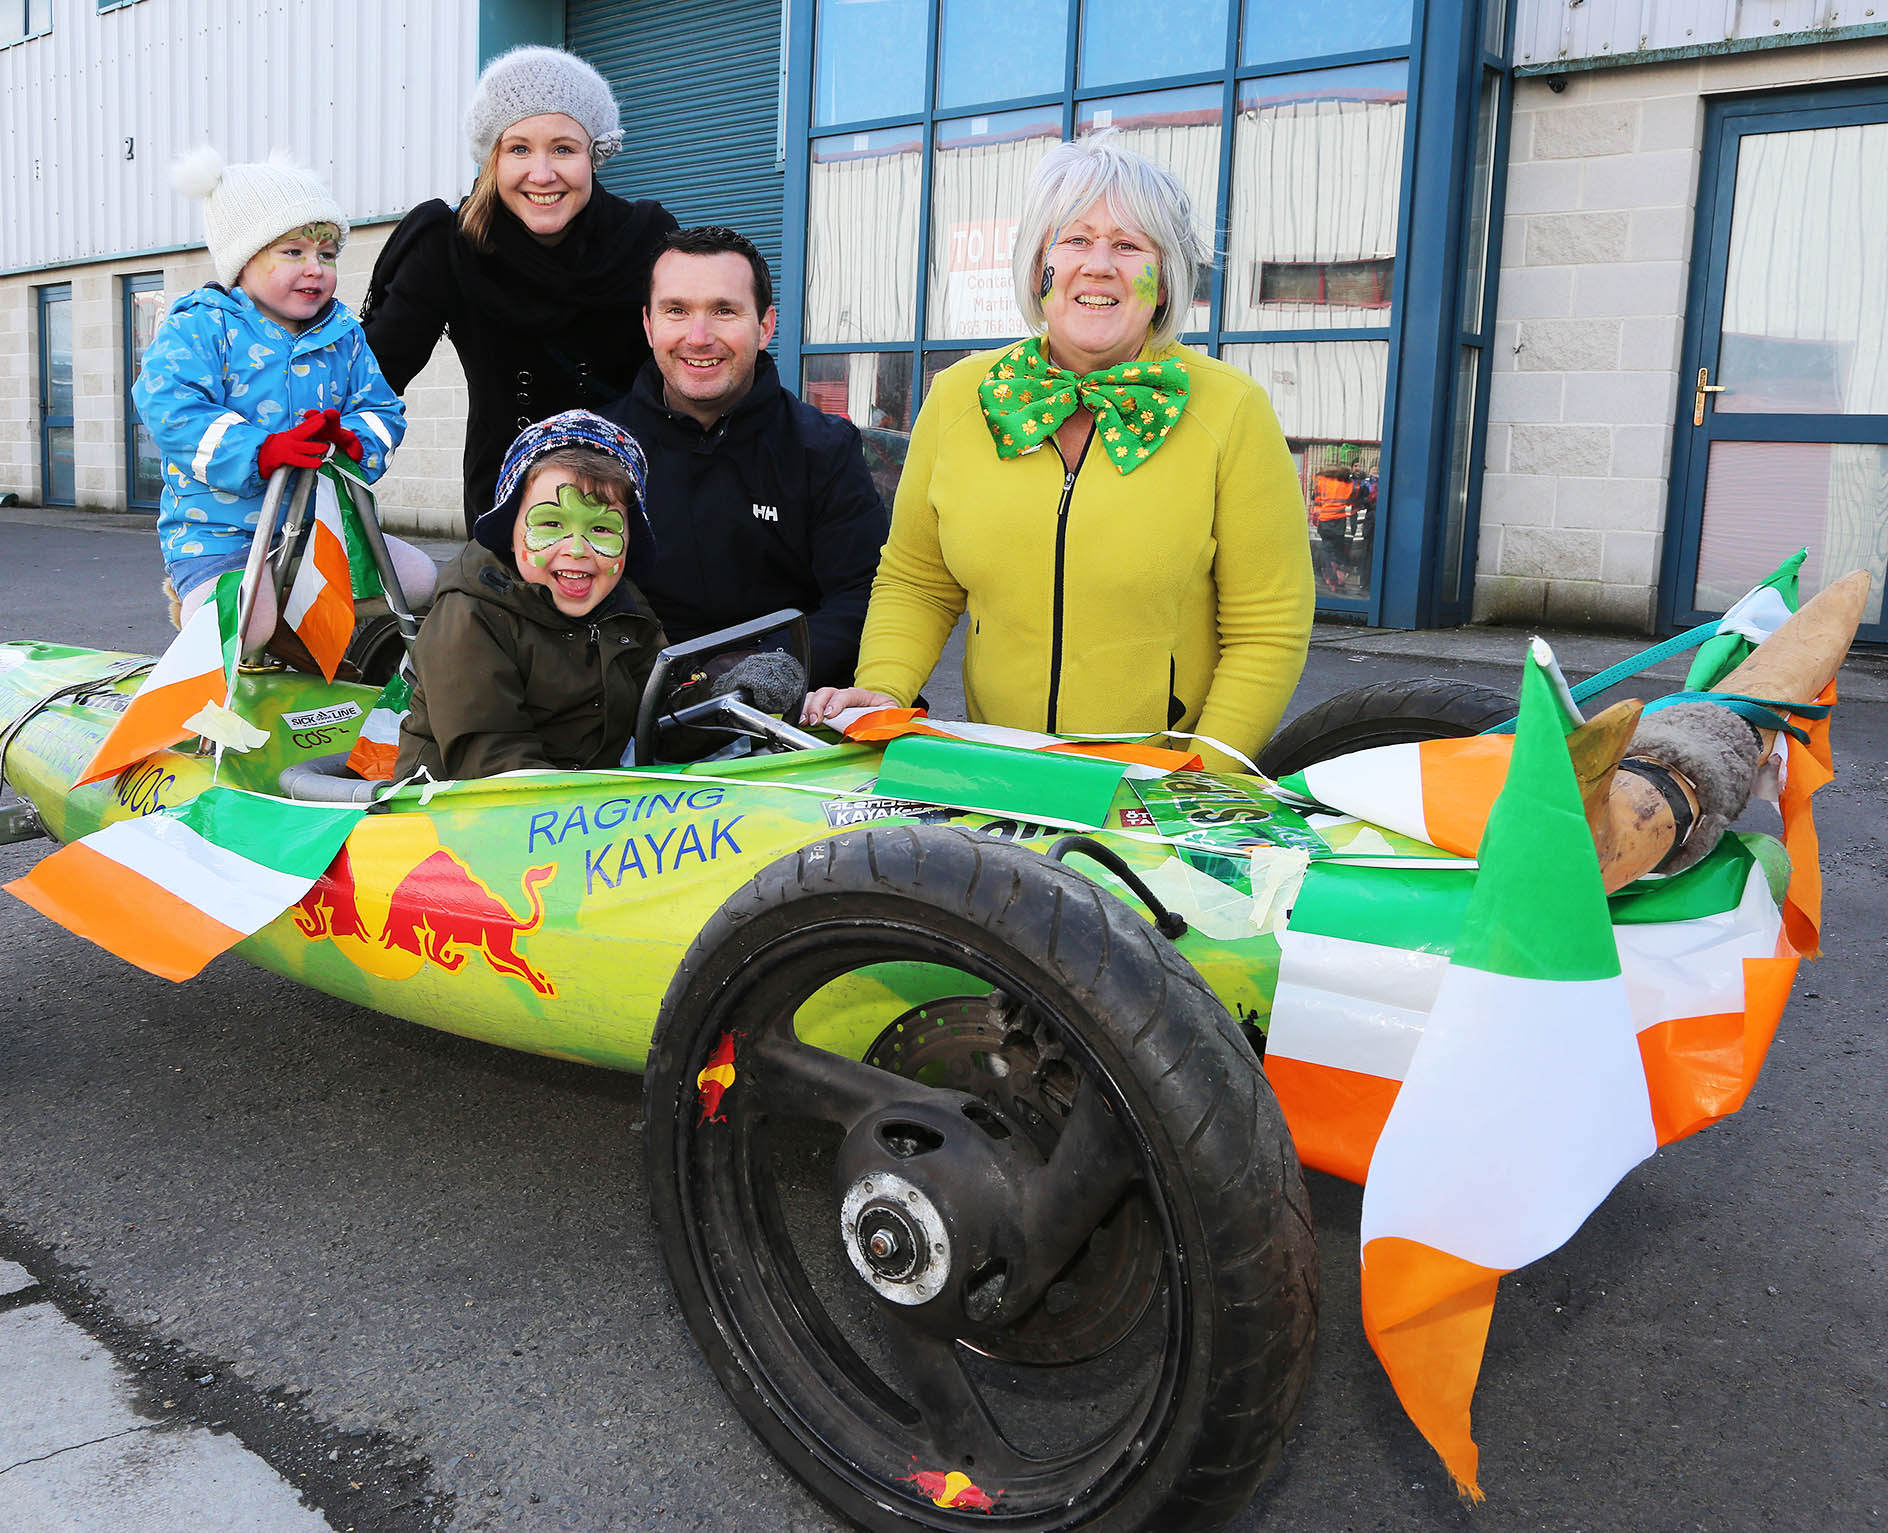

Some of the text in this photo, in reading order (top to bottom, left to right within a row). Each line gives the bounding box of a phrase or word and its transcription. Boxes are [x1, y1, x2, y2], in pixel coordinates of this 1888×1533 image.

[953, 226, 1018, 263] TO LE
[967, 275, 1015, 290] Contac
[753, 503, 778, 521] HH
[291, 716, 316, 726] SICK
[332, 707, 357, 719] LINE
[529, 787, 726, 854] RAGING
[585, 815, 745, 895] KAYAK
